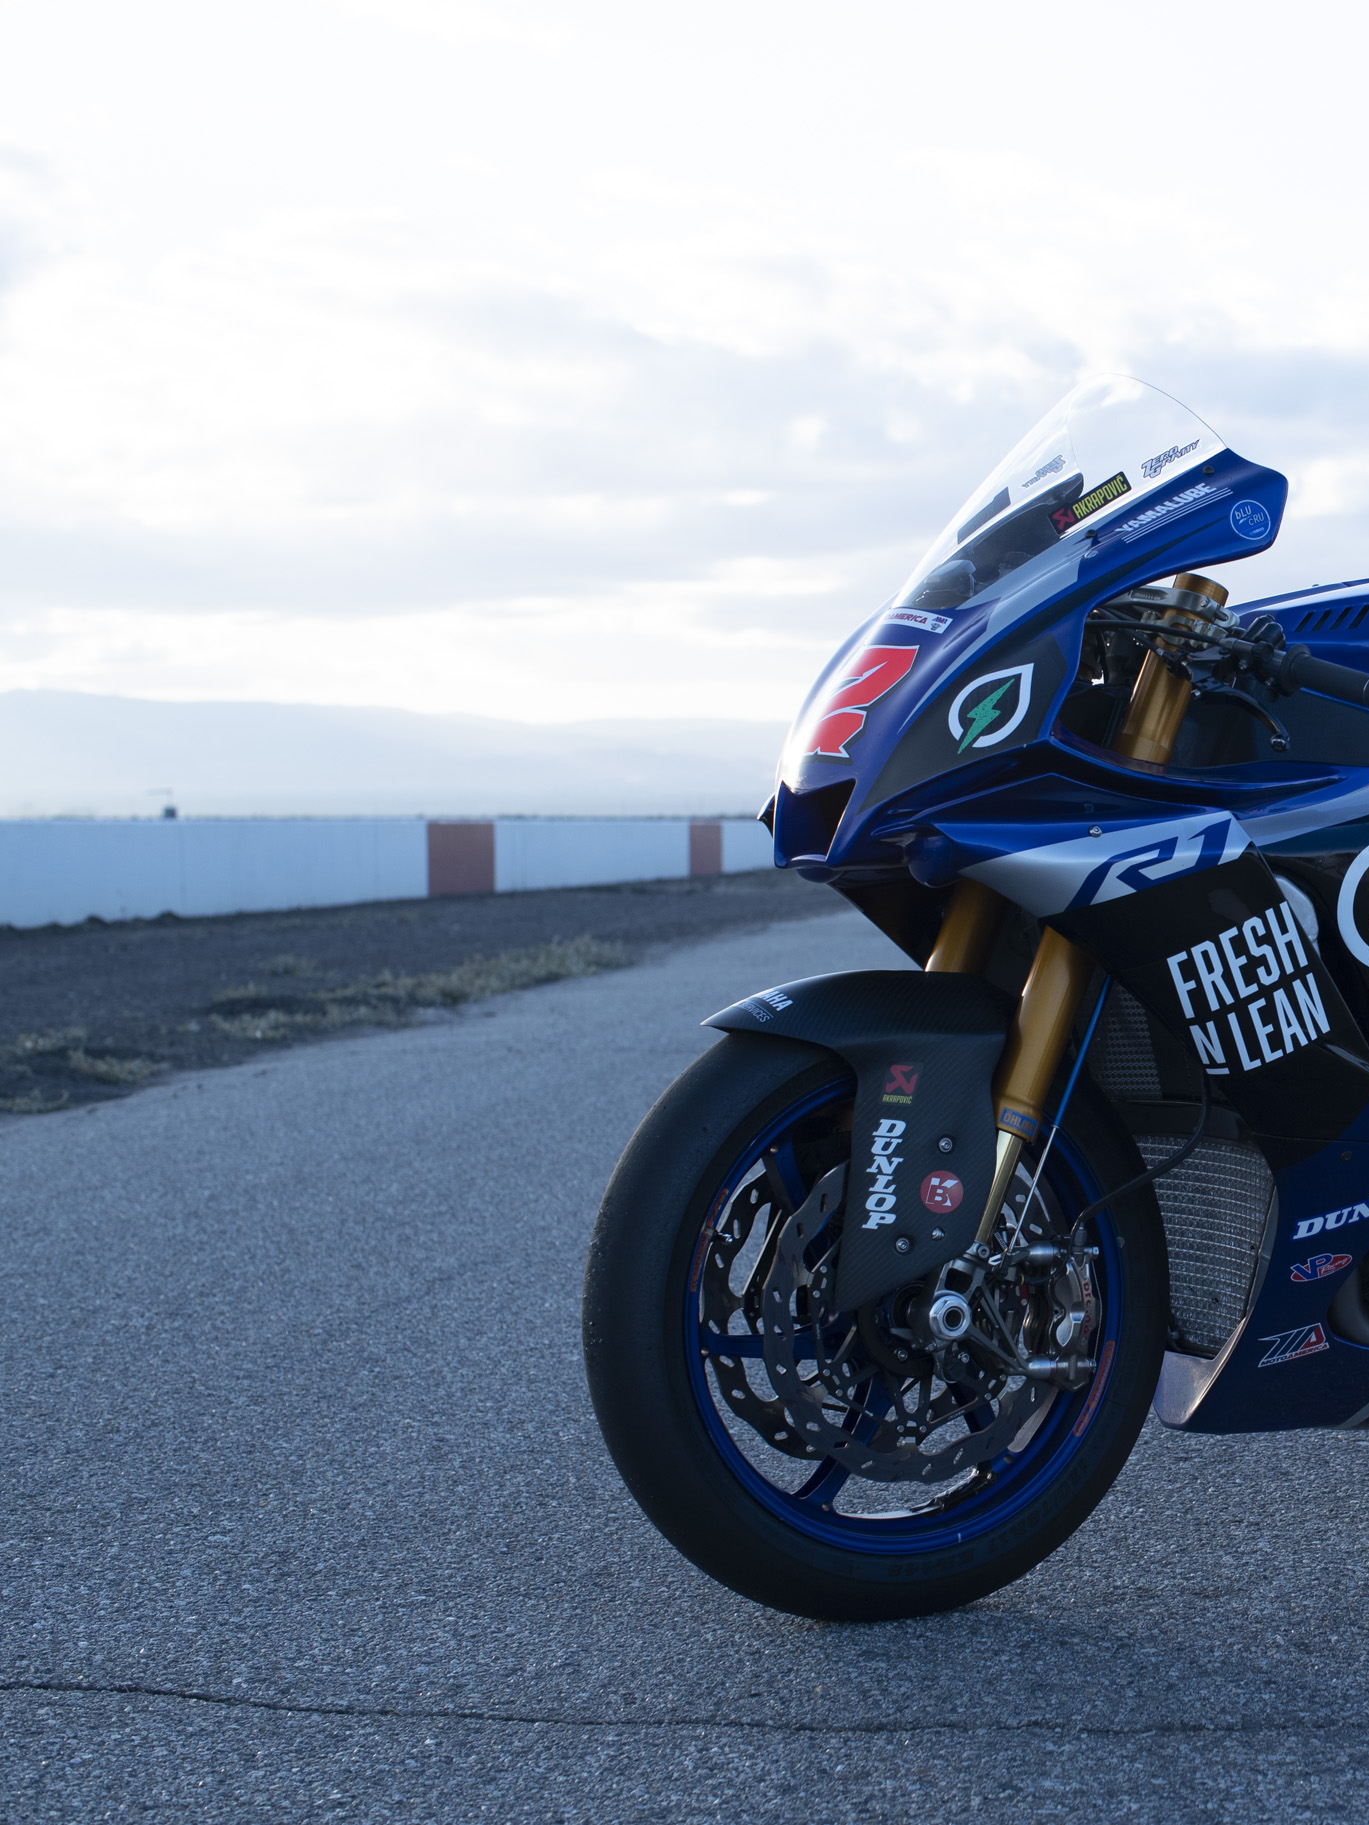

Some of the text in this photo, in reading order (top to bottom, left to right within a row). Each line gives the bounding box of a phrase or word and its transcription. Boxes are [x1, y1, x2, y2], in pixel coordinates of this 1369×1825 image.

[1114, 482, 1217, 534] YAMALUBE
[802, 645, 919, 758] 2
[1166, 900, 1309, 1019] FRESH
[1227, 972, 1331, 1072] LEAN
[861, 1118, 907, 1230] DUNLOP
[1290, 1253, 1334, 1281] VP
[1259, 1342, 1330, 1367] MOTOAMERICA
